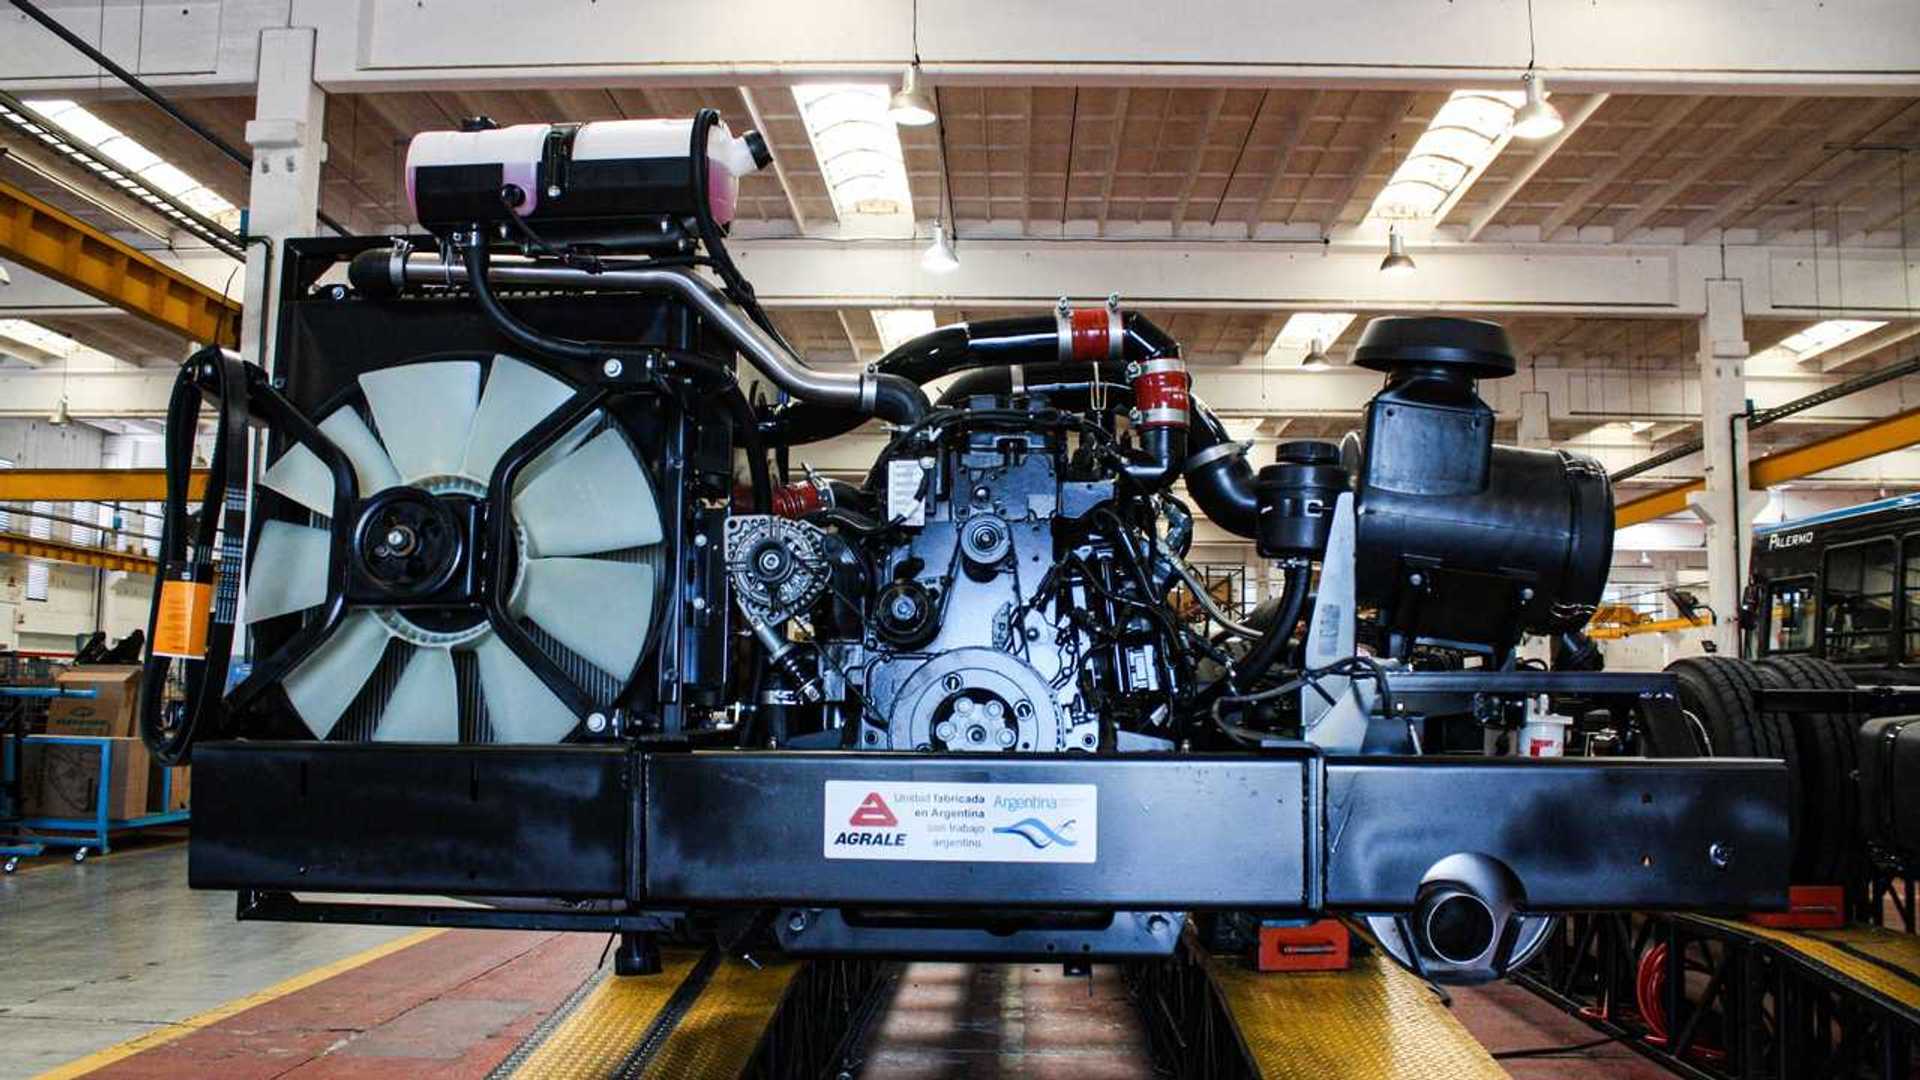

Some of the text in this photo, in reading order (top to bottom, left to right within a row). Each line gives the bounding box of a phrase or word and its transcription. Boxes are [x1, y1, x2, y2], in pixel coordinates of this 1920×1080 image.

[933, 792, 985, 804] fabricada
[993, 795, 1058, 812] Argentina
[914, 808, 985, 819] en Argentina
[834, 832, 907, 847] AGRALE
